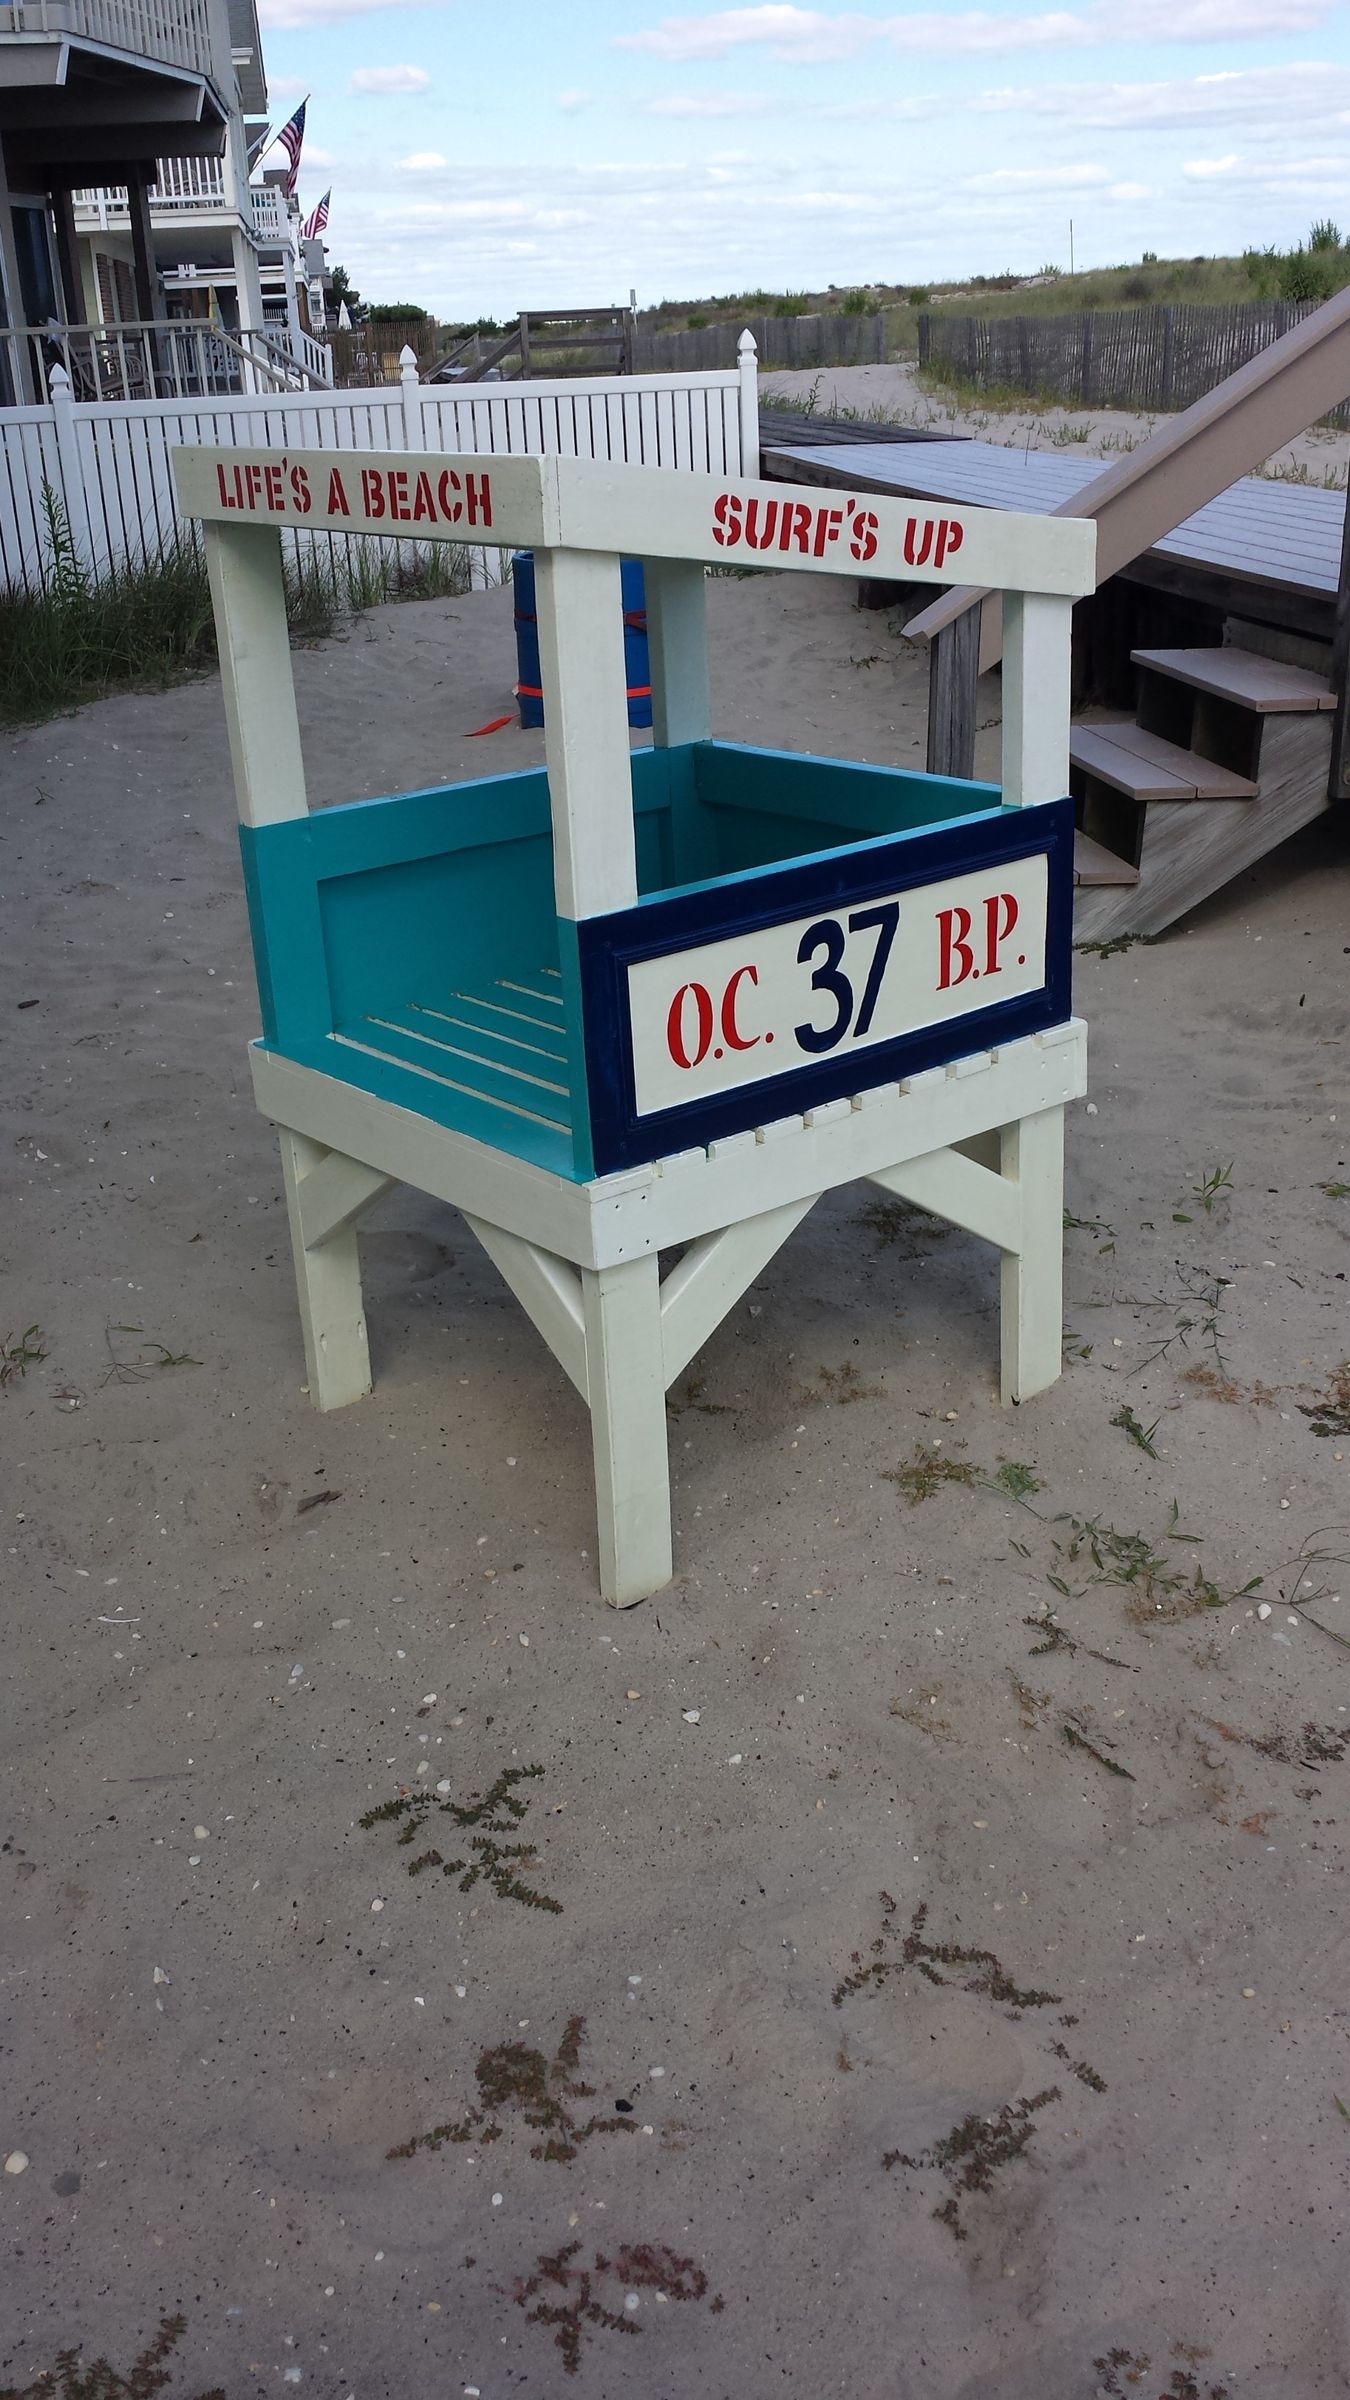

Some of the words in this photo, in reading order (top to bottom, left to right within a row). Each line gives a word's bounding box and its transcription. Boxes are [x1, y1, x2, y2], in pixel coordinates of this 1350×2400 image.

[216, 456, 312, 514] LIFE'S
[327, 467, 351, 516] A
[360, 468, 493, 528] BEACH
[711, 493, 880, 561] SURF'S
[902, 517, 965, 569] UP
[666, 964, 775, 1069] O.C.
[793, 900, 900, 1055] 37
[934, 893, 1026, 992] B.P.
